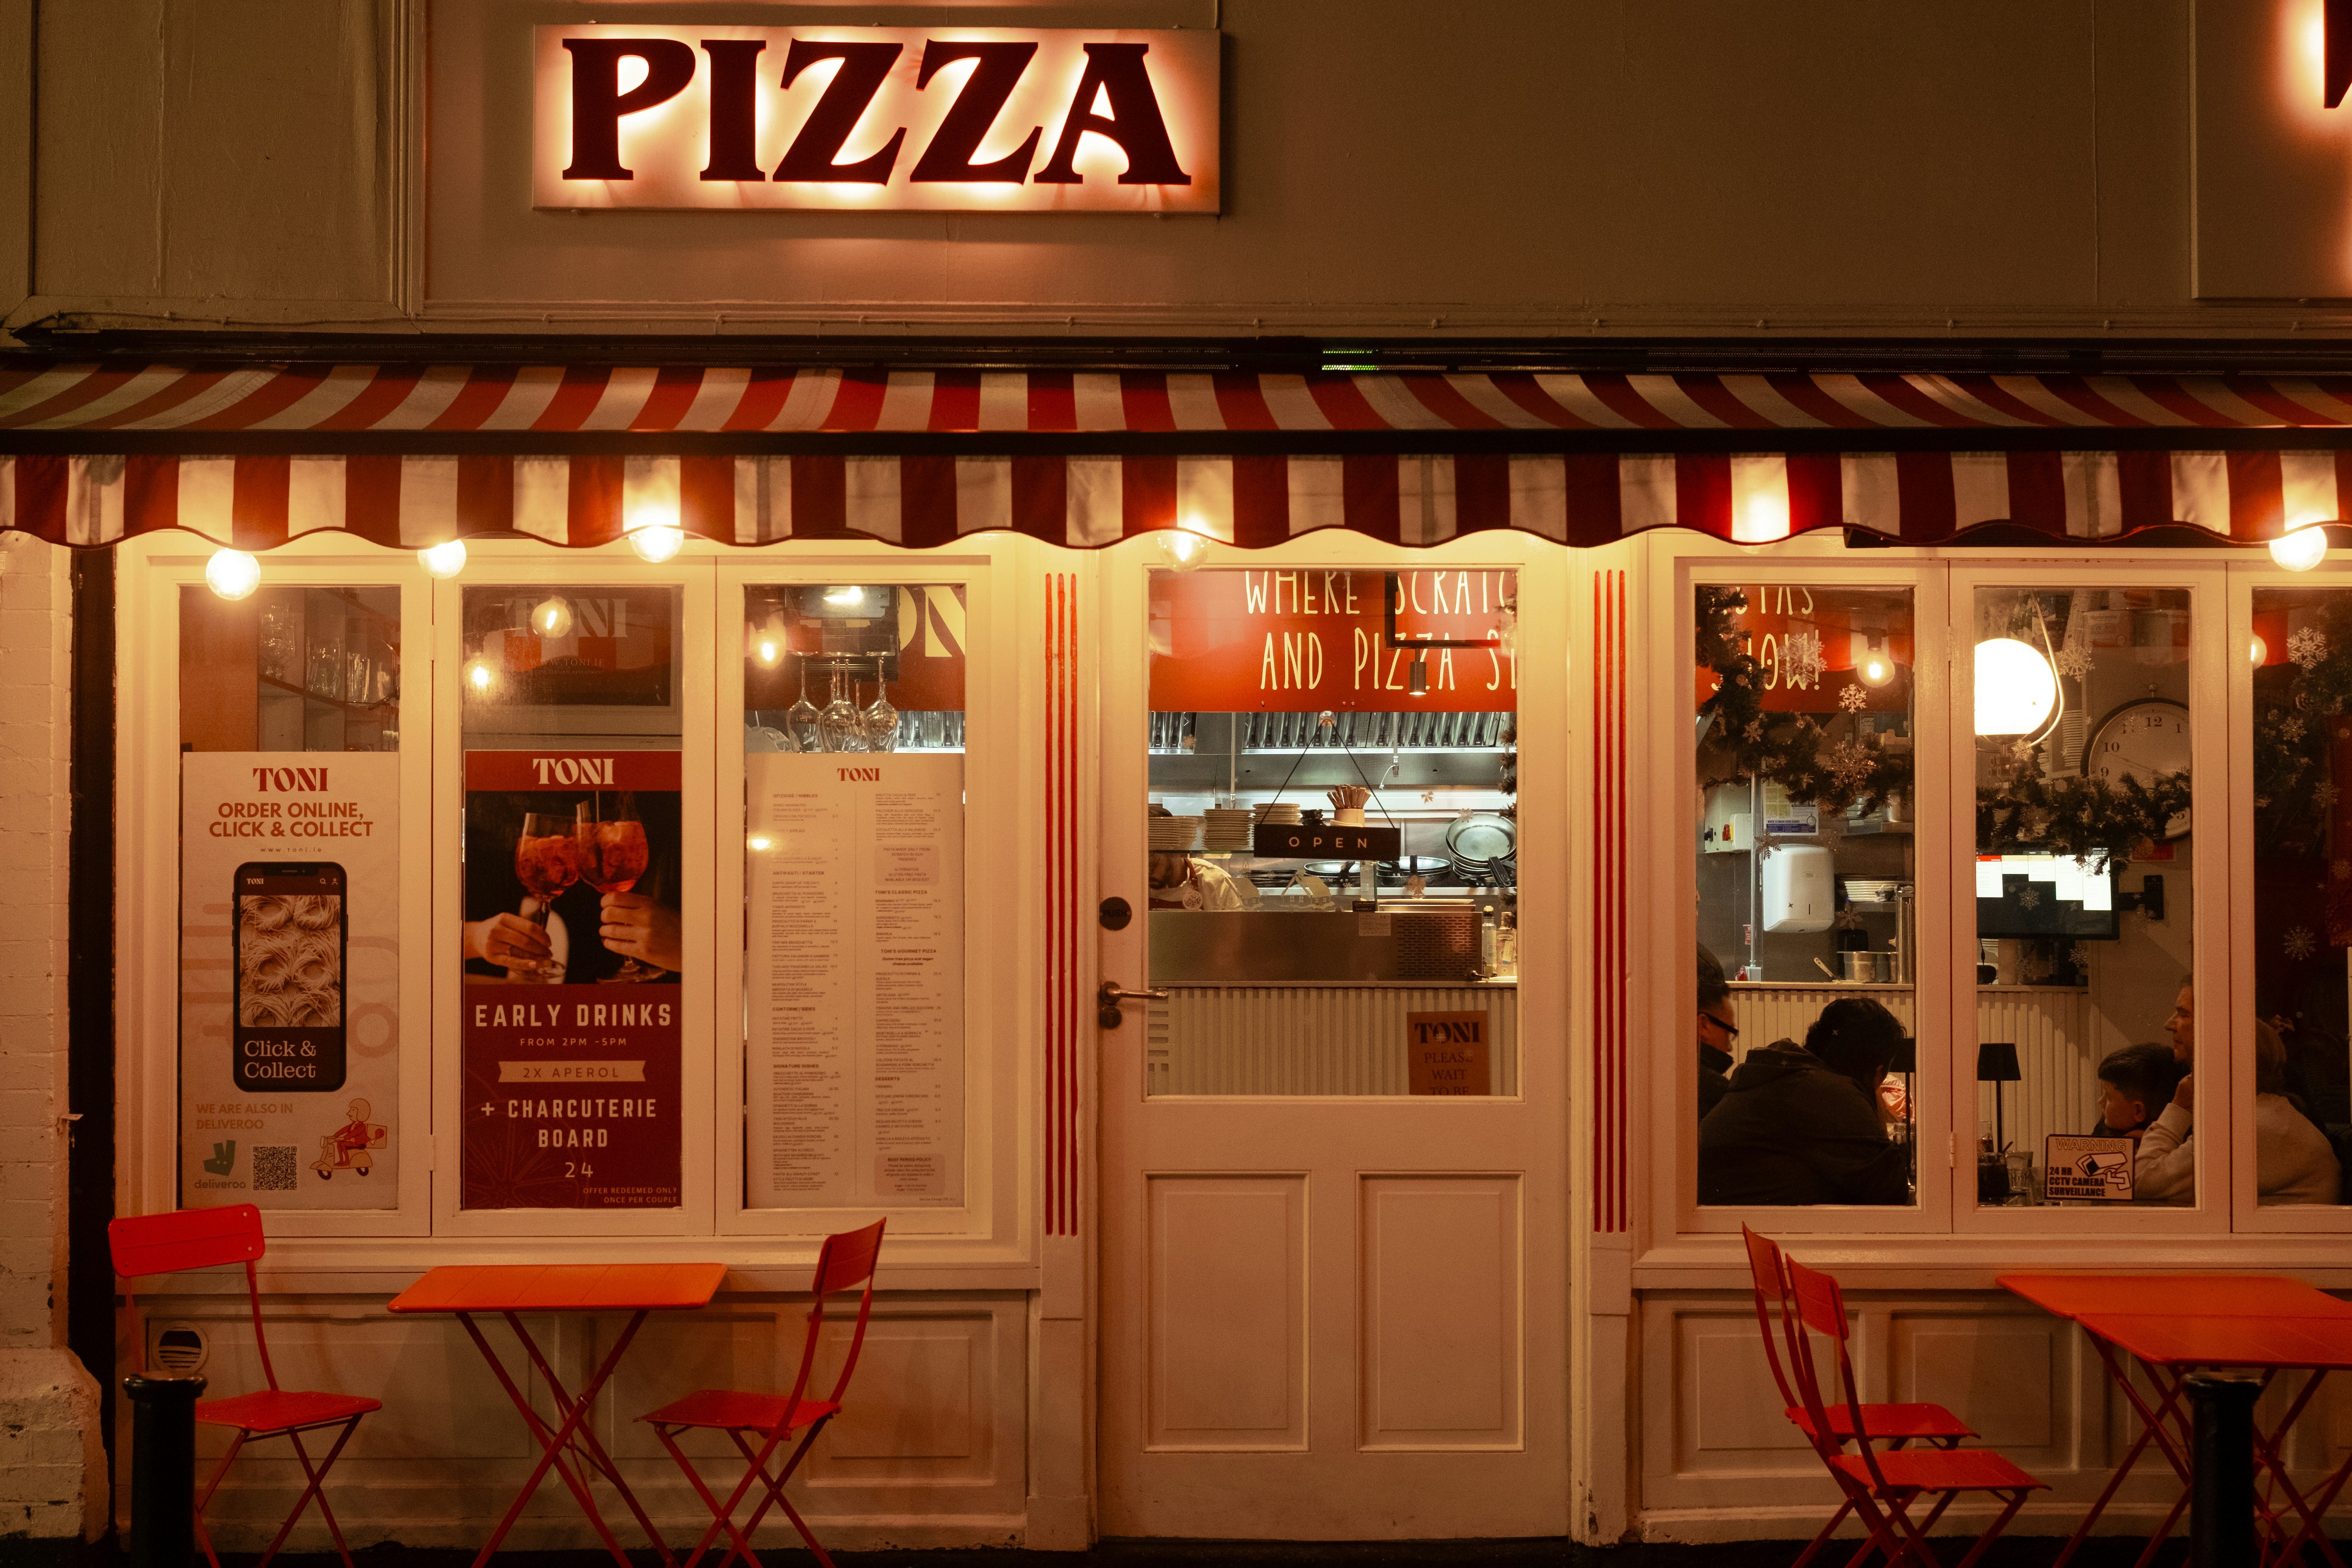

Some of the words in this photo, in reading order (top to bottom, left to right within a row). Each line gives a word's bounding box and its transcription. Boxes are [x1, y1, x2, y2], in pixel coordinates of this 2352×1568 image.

[562, 38, 1191, 186] PIZZA
[1245, 571, 1360, 615] WHERE
[505, 598, 628, 637] TNI
[1260, 632, 1323, 690] AND
[2146, 716, 2162, 727] 12
[2175, 723, 2181, 733] 1
[2104, 742, 2120, 753] 10
[533, 758, 615, 784] TONI
[837, 768, 880, 781] TONI
[2100, 767, 2109, 777] 9
[253, 768, 329, 792] TONI
[218, 802, 281, 818] ORDER
[288, 802, 363, 821] ONLINE,
[209, 821, 265, 837] CLICK
[270, 821, 286, 837] &
[290, 821, 373, 837] COLLECT
[1289, 835, 1368, 849] OPEN
[476, 1004, 561, 1027] EARLY
[577, 1004, 671, 1026] DRINKS
[1414, 1022, 1480, 1043] TONI
[244, 1040, 296, 1057] Click
[300, 1041, 316, 1057] &
[595, 1038, 627, 1046] -5PM
[244, 1062, 316, 1078] Collect
[523, 1069, 542, 1078] 2X
[552, 1068, 619, 1078] APEROL
[1431, 1069, 1467, 1080] WAIT
[1429, 1086, 1449, 1095] TO
[197, 1104, 215, 1114] WE
[218, 1104, 241, 1114] ARE
[245, 1103, 277, 1114] ALSO
[280, 1104, 293, 1114] IN
[481, 1103, 494, 1116] +
[508, 1099, 657, 1118] CHARCUTERIE
[197, 1119, 264, 1129] DELIVEROO
[539, 1129, 607, 1147] BOARD
[2055, 1139, 2127, 1152] WARNING
[565, 1162, 594, 1178] 24
[2049, 1167, 2060, 1175] 24
[2061, 1167, 2072, 1176] HR
[194, 1179, 246, 1189] deliveroo
[2049, 1177, 2071, 1186] CCTV
[2072, 1178, 2105, 1186] CAMERA
[2049, 1187, 2106, 1197] SURVEILLANCE
